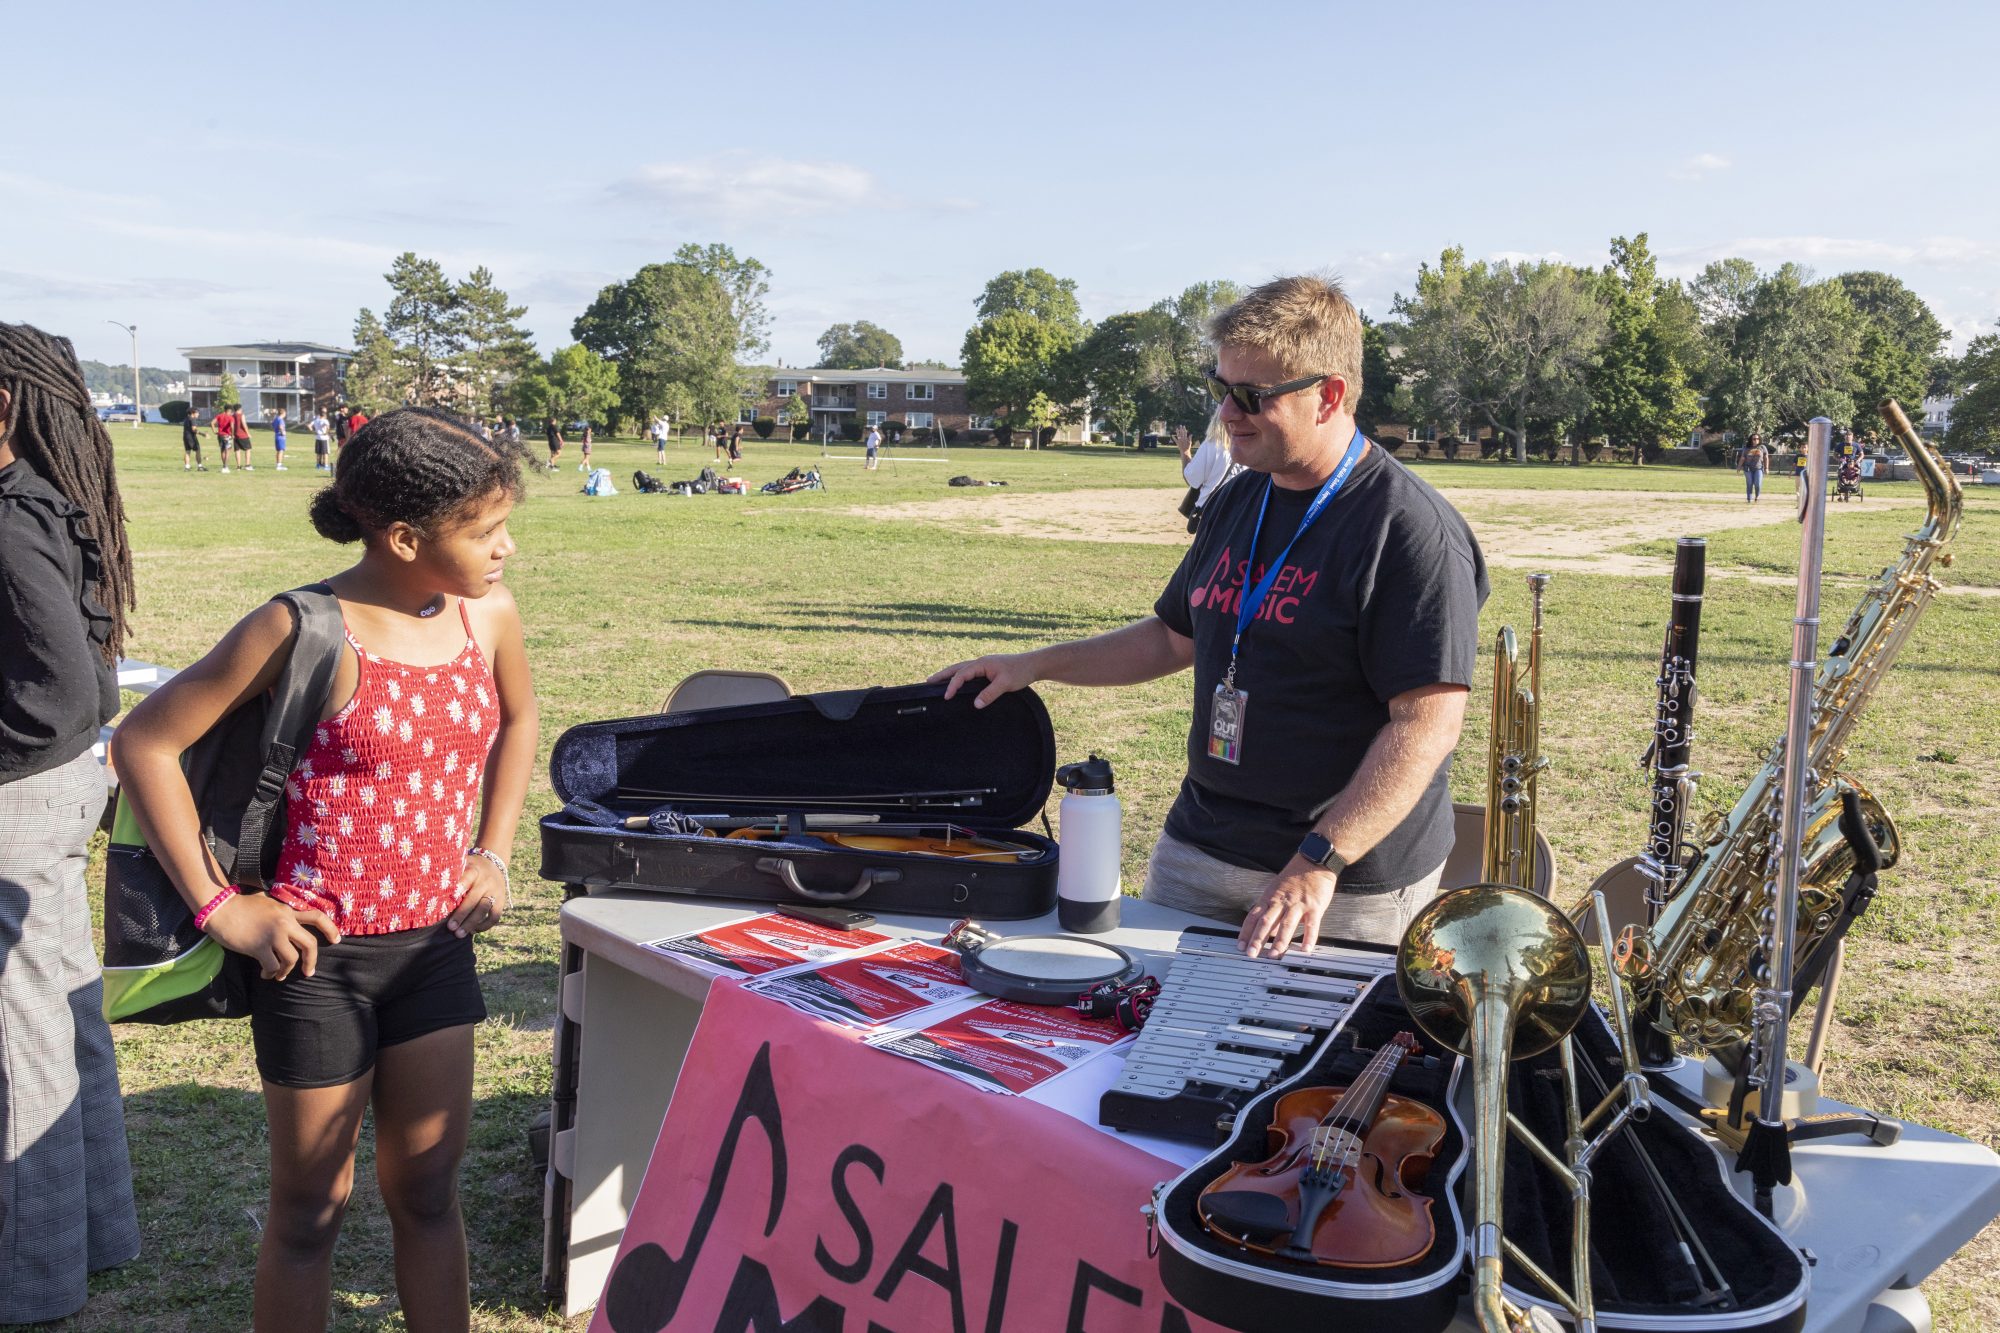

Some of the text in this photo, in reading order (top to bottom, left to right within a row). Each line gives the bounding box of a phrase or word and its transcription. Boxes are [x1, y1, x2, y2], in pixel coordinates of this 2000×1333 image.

[1231, 559, 1319, 597] SAEM
[1214, 719, 1237, 736] OUT
[1030, 1017, 1057, 1028] BANDA
